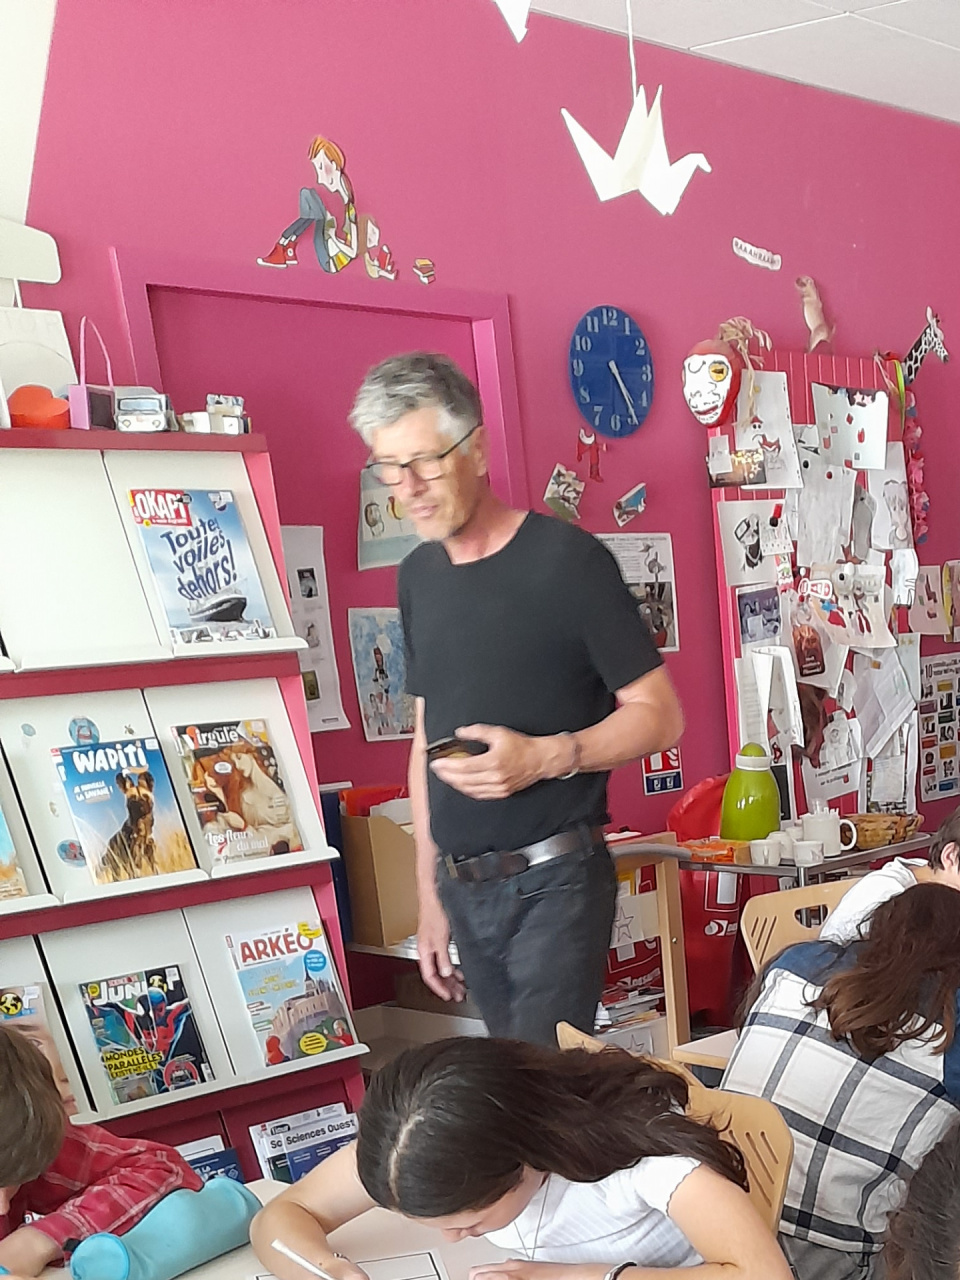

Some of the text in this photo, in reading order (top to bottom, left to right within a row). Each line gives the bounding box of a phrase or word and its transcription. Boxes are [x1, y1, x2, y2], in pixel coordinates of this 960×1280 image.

[586, 316, 599, 333] 11
[602, 308, 618, 326] 12
[624, 317, 631, 335] 1
[575, 335, 592, 352] 10
[635, 338, 645, 356] 2
[573, 359, 584, 377] 9
[642, 364, 652, 382] 3
[580, 386, 590, 404] 8
[638, 389, 648, 407] 4
[593, 405, 603, 426] 7
[610, 414, 621, 431] 6
[134, 490, 187, 519] OKAPI
[173, 529, 225, 574] voiles
[177, 539, 237, 601] dehors!
[182, 725, 239, 750] Virgule
[240, 928, 314, 963] ARKÉO
[105, 1047, 145, 1061] MONDES
[286, 1127, 326, 1145] Sciences
[327, 1118, 356, 1134] Ouest
